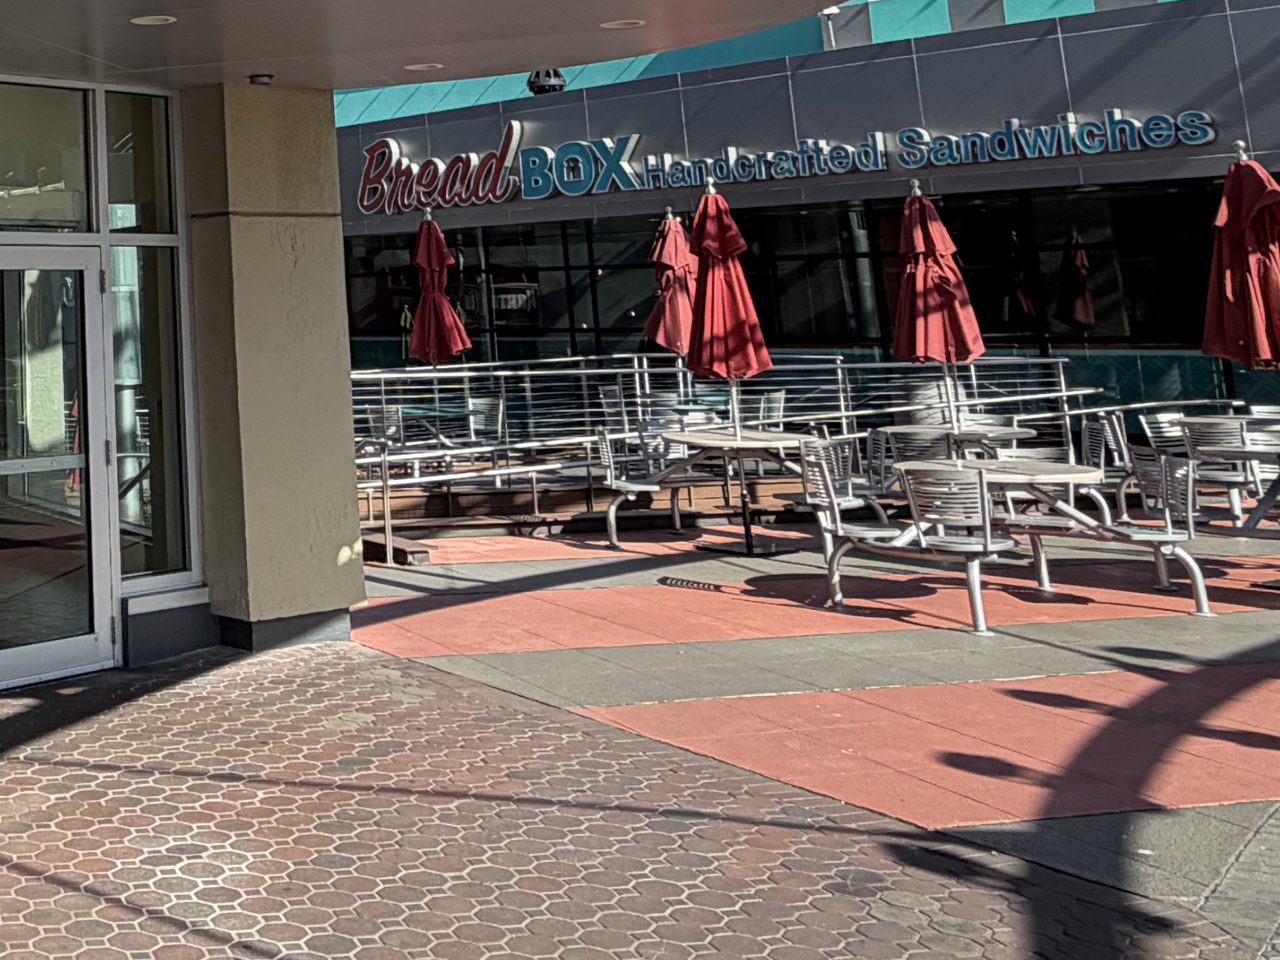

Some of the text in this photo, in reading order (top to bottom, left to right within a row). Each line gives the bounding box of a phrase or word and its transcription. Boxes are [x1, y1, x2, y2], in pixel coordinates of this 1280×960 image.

[357, 108, 1217, 215] Bread BOX Handcrafted Sandwiches
